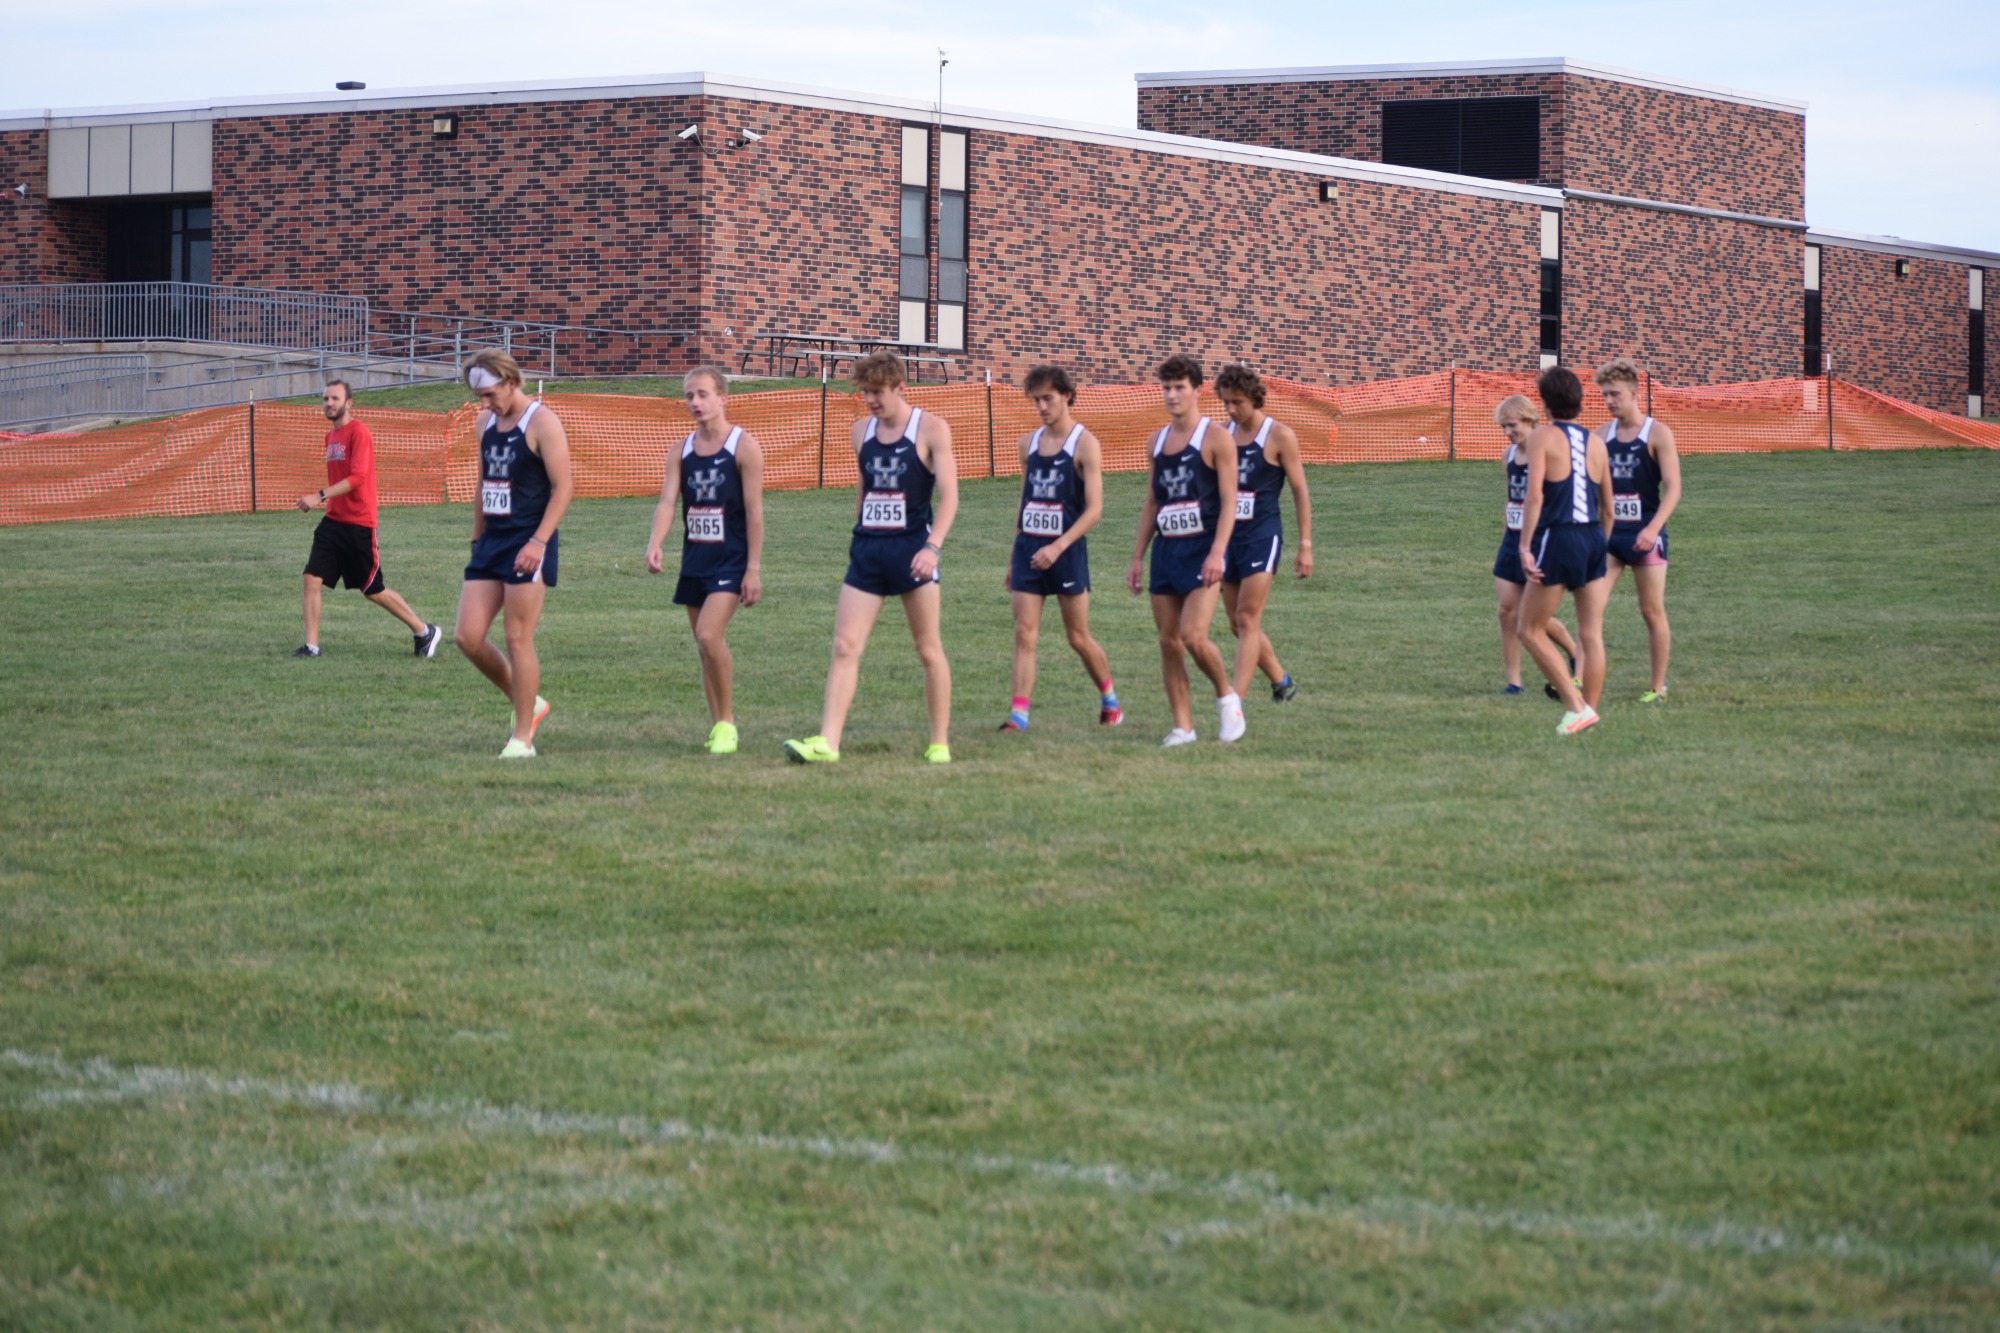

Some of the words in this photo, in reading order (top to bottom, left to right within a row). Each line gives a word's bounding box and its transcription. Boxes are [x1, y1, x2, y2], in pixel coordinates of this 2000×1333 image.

[866, 503, 902, 521] 2655
[1236, 500, 1251, 515] 58
[1614, 502, 1638, 516] 649
[688, 517, 720, 535] 2665
[1025, 512, 1059, 530] 2660
[1160, 512, 1198, 531] 2669
